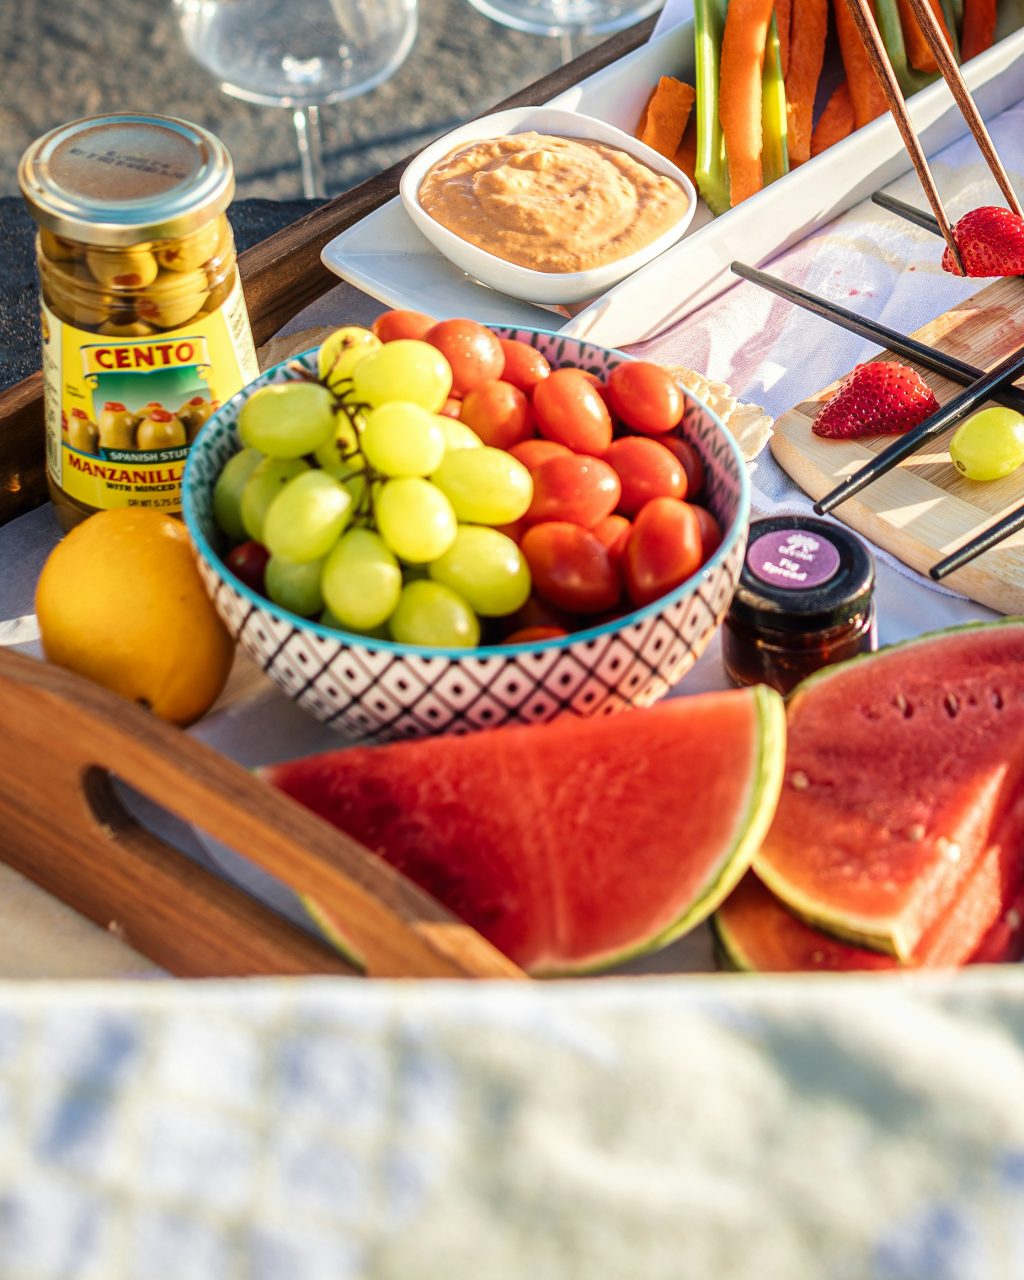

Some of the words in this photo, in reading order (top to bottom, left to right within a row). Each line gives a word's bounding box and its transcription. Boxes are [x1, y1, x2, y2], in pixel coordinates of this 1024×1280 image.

[94, 342, 195, 369] CENTO
[109, 451, 158, 462] SPANISH
[68, 454, 185, 485] MANZANILL
[106, 482, 132, 492] WITH
[135, 483, 175, 492] MINCED
[762, 561, 808, 582] Spread
[779, 558, 800, 572] Fig
